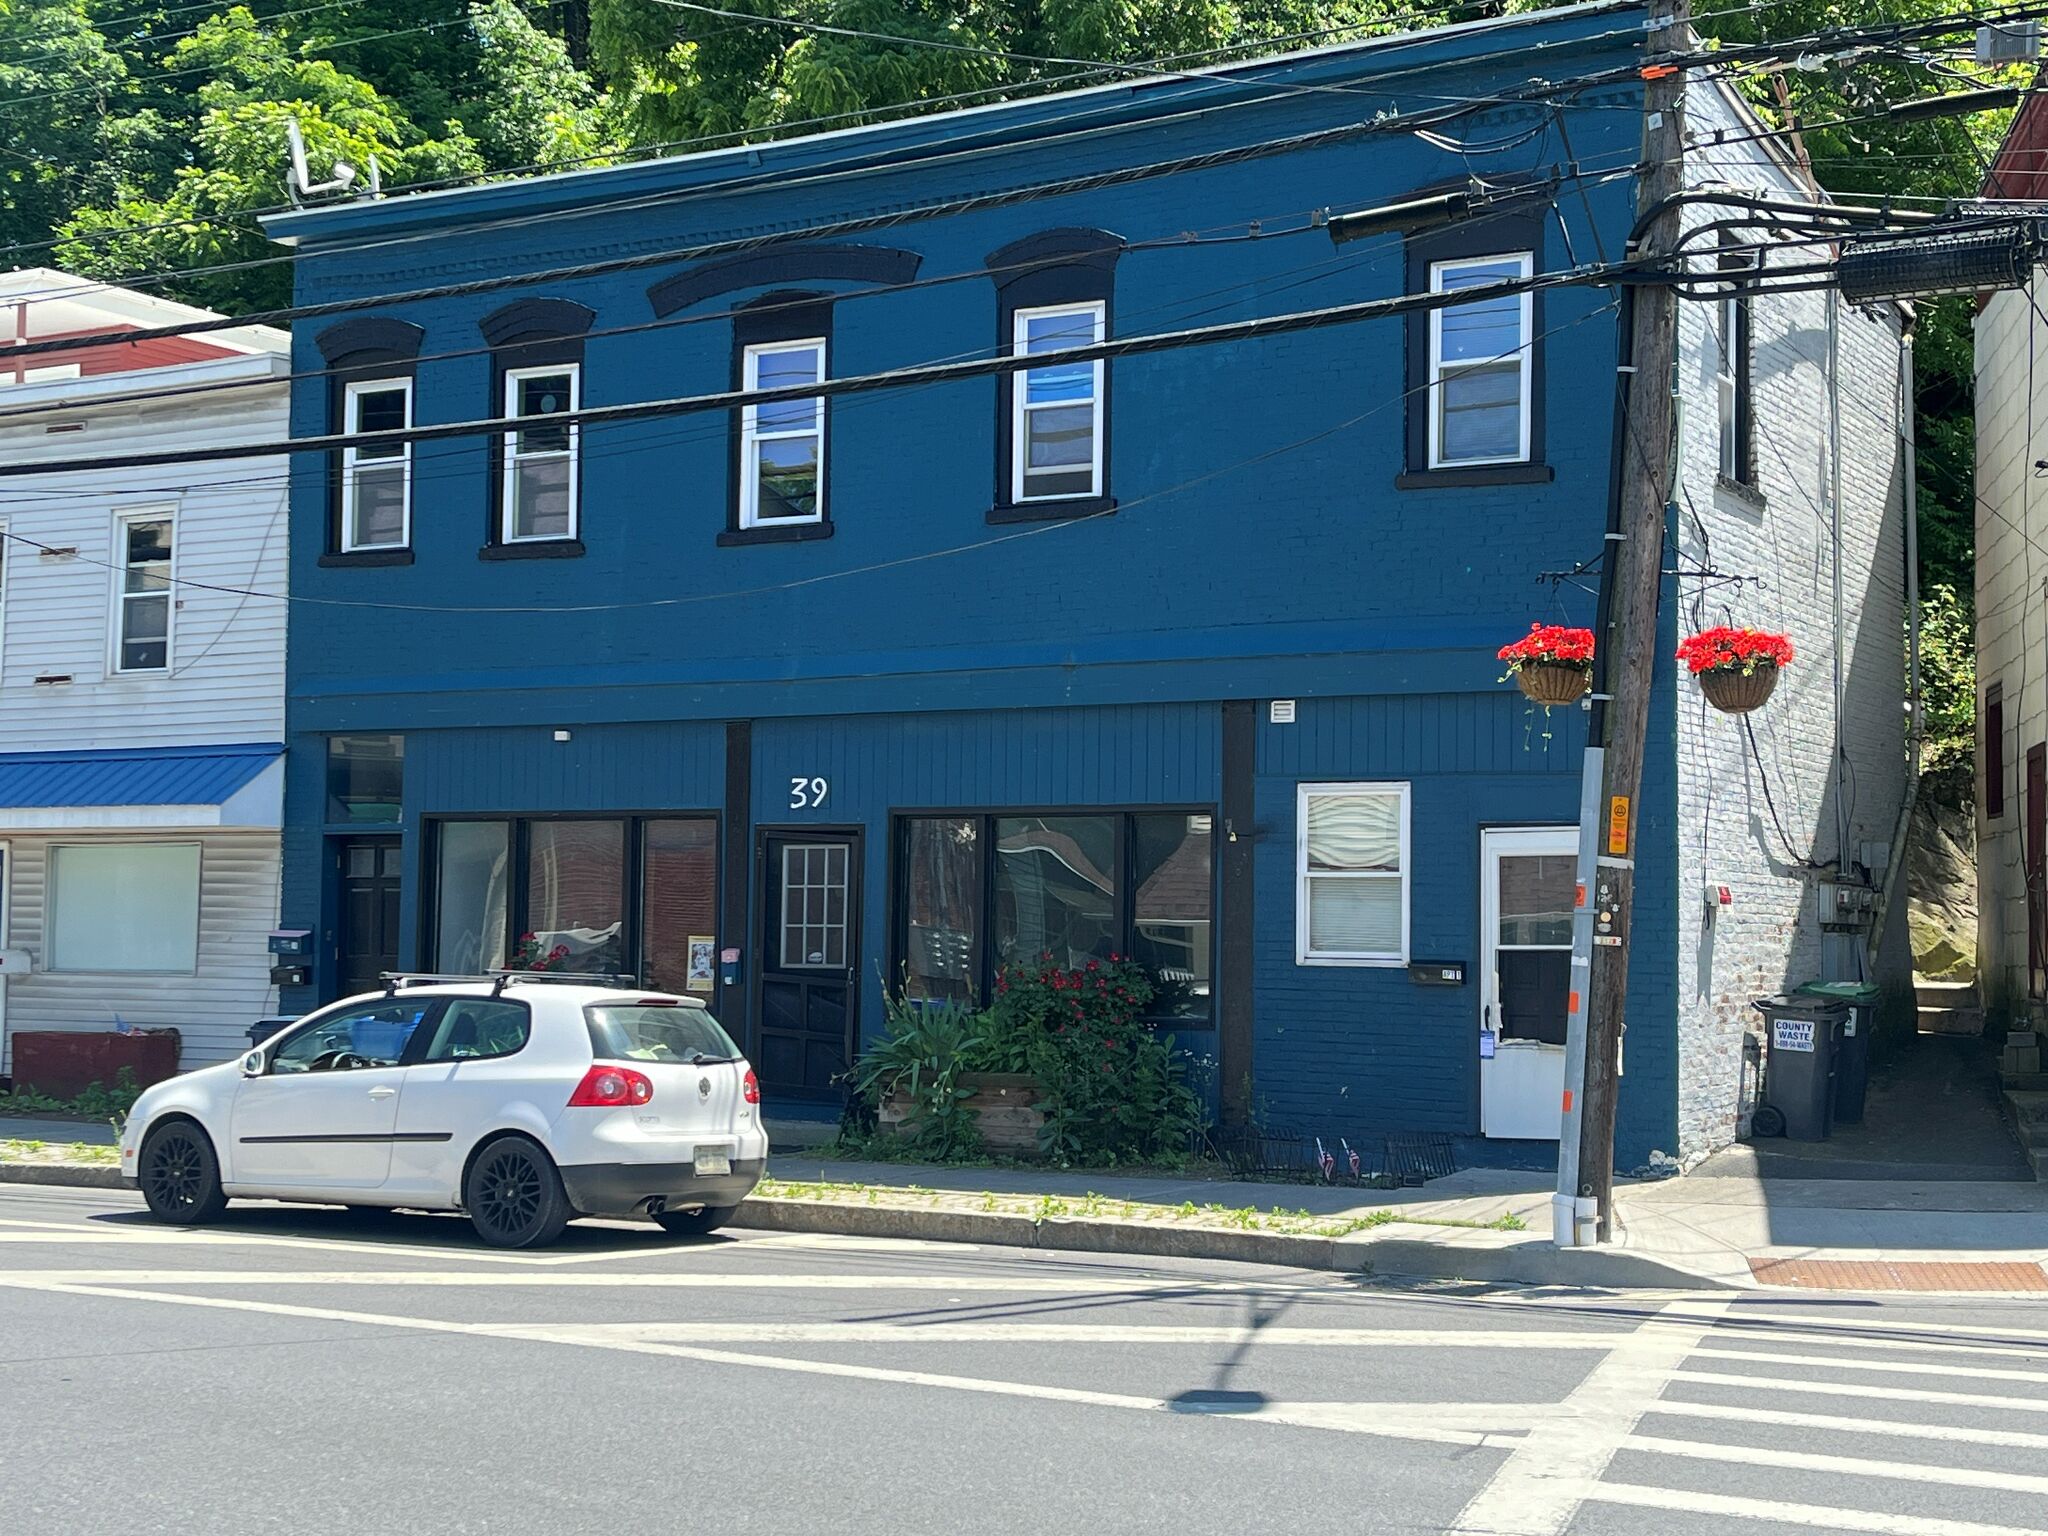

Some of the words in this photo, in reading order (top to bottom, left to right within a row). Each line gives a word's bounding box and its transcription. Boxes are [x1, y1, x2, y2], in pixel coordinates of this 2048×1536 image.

[790, 777, 828, 809] 39
[1776, 1021, 1812, 1032] COUNTY
[1779, 1030, 1810, 1041] WASTE
